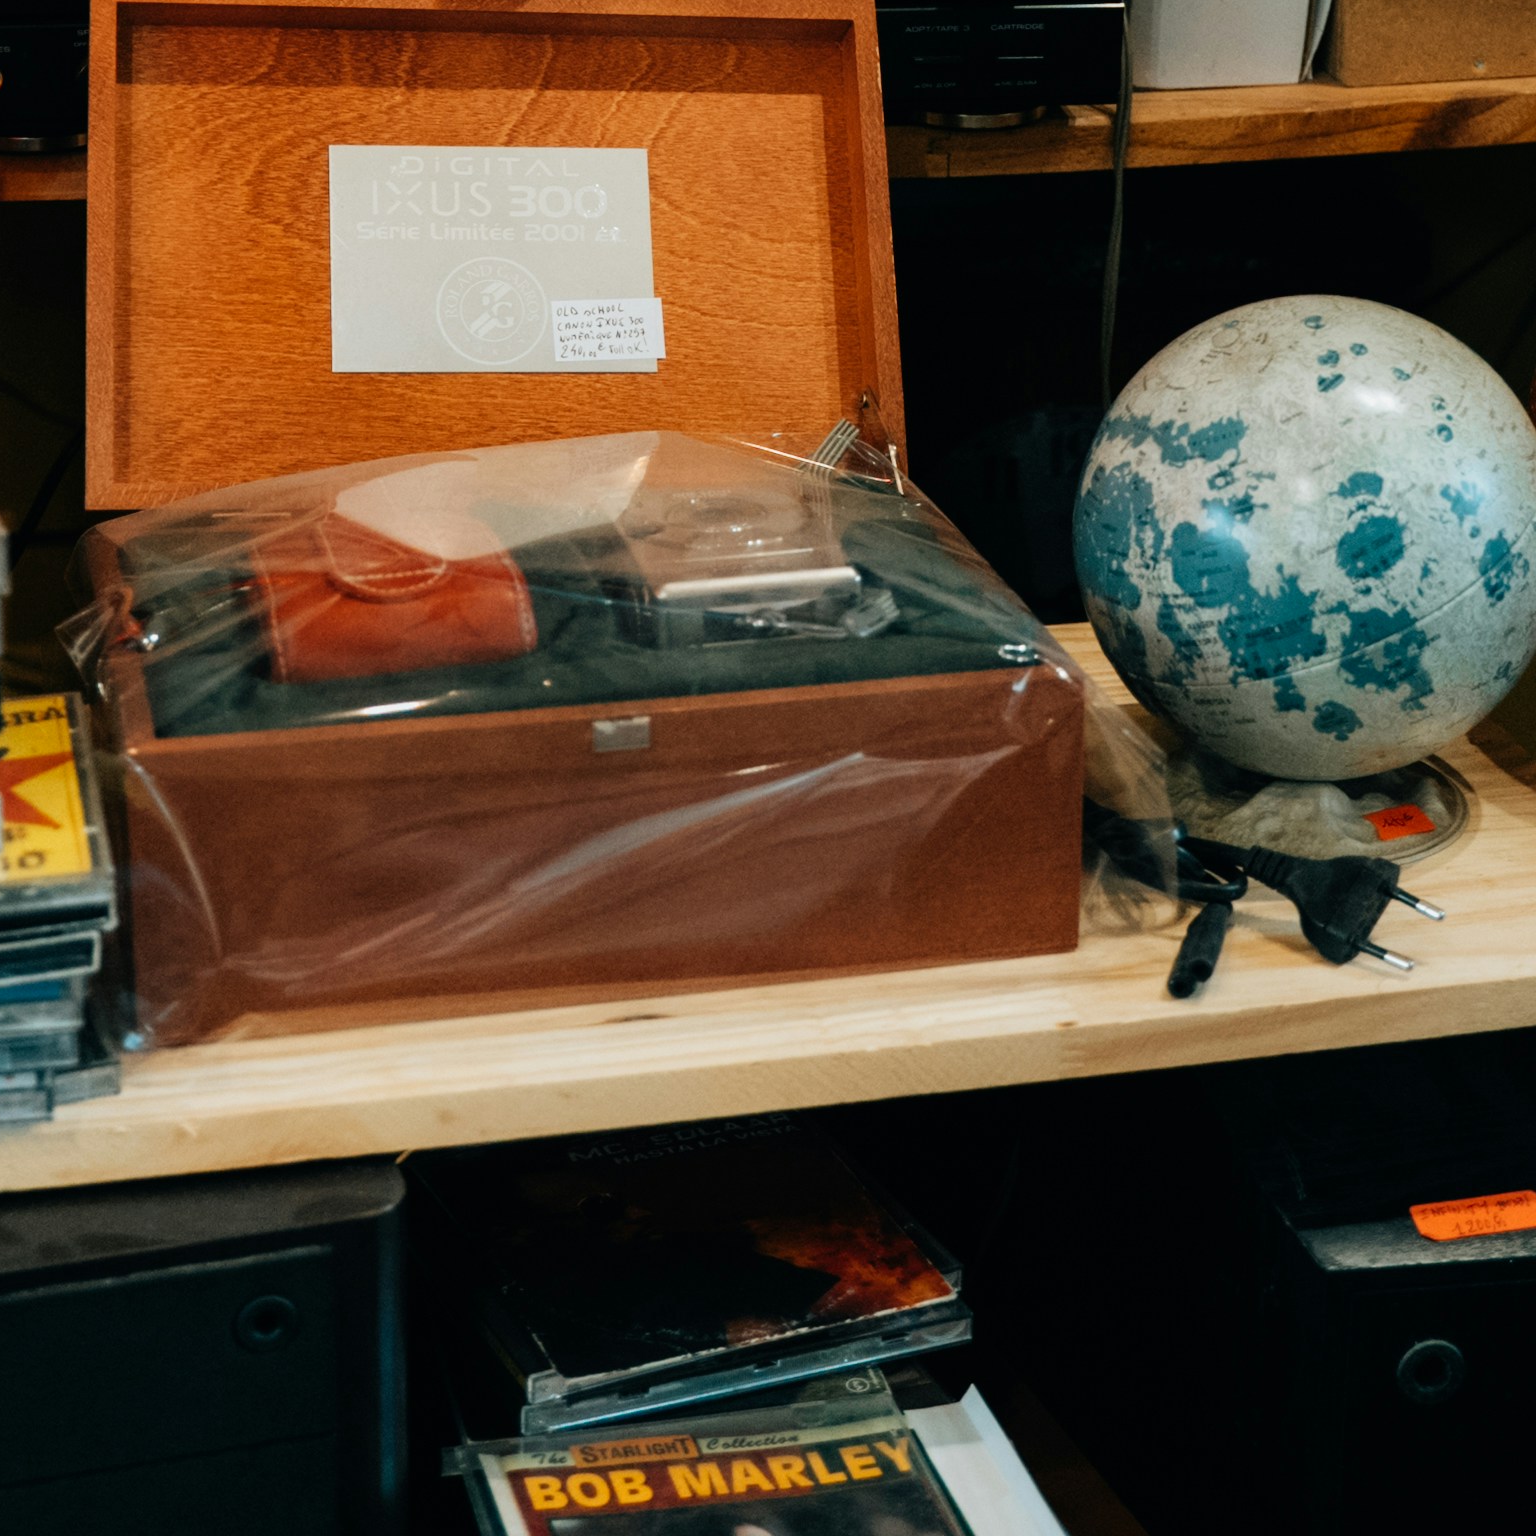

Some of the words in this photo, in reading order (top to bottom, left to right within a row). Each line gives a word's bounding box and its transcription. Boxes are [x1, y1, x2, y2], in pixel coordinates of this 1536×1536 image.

[990, 22, 1045, 32] CARTRIDGE
[371, 179, 494, 218] IXUS
[507, 183, 609, 219] 300
[356, 221, 421, 241] Série
[429, 221, 516, 242] Limitée
[524, 222, 585, 242] 2001
[556, 305, 579, 318] OLD
[557, 321, 594, 332] CANON
[530, 1451, 569, 1466] The
[705, 1433, 799, 1452] Collection
[524, 1468, 654, 1511] BOB
[668, 1437, 913, 1501] MARLEY
